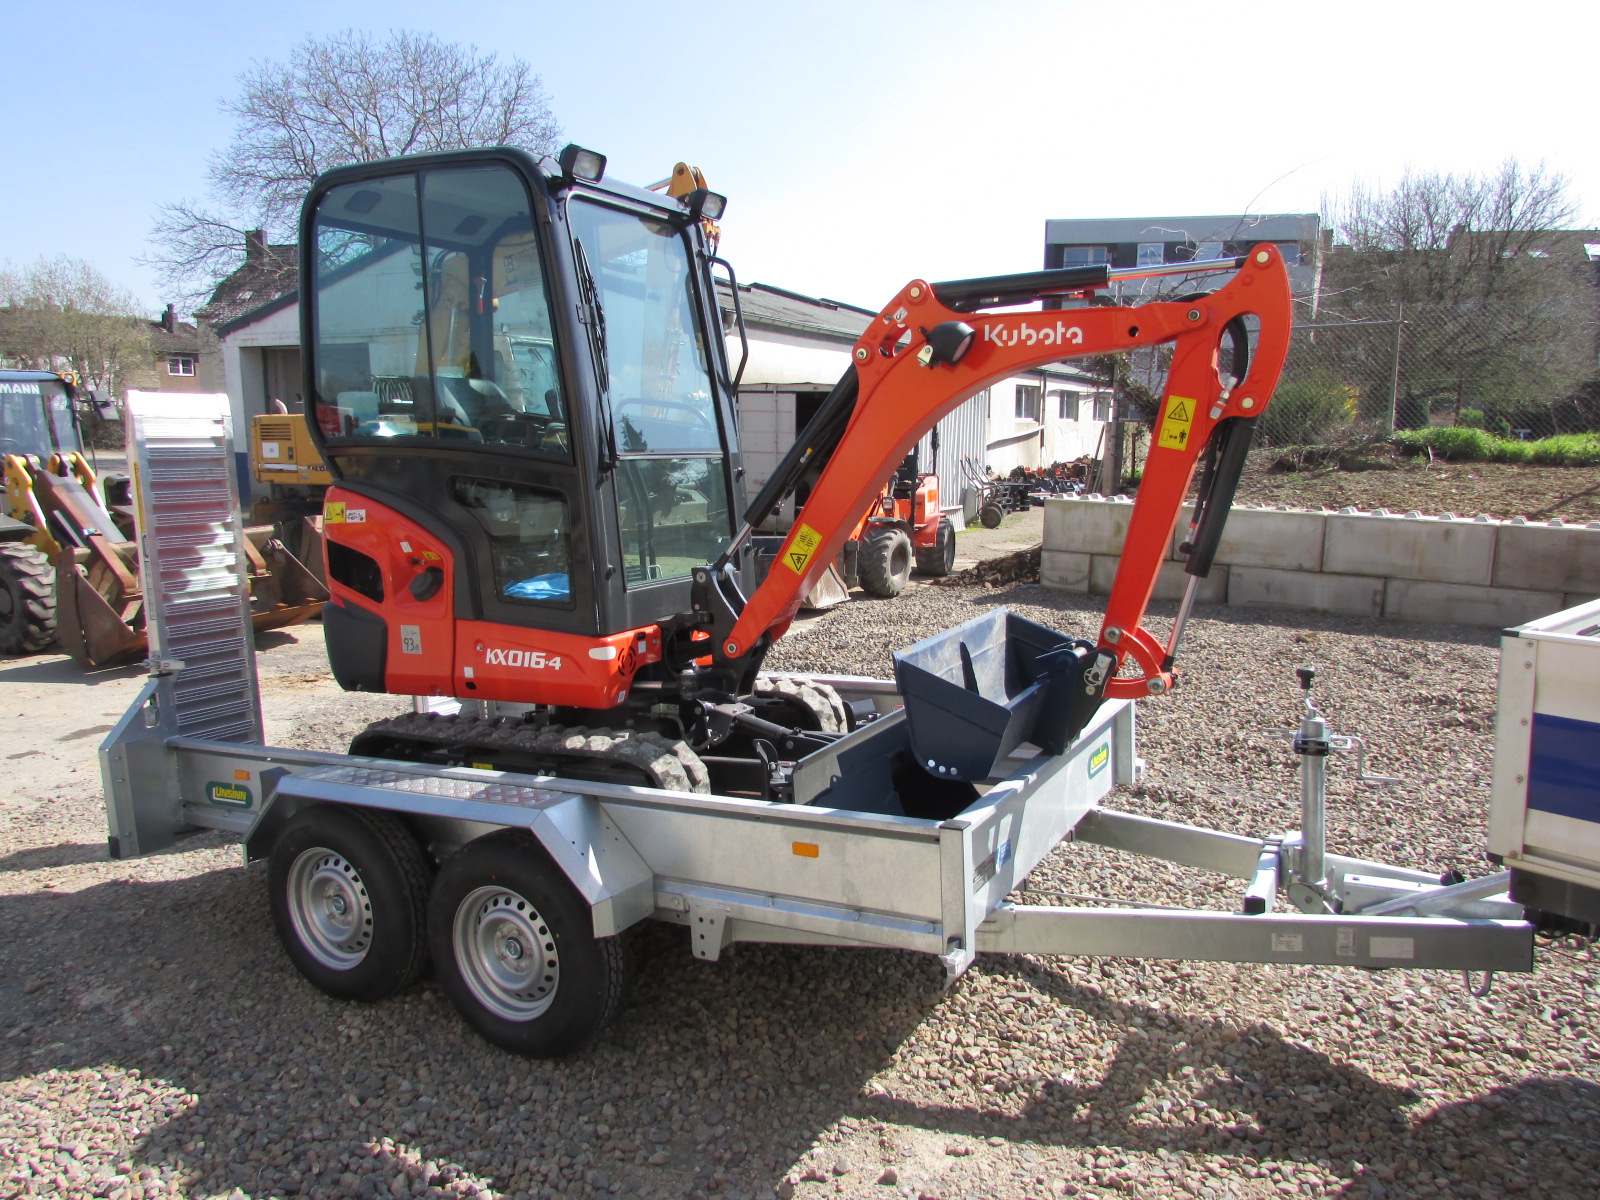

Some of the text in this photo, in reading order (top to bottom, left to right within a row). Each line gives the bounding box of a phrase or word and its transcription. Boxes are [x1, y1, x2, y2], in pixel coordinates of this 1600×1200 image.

[984, 321, 1083, 347] Kubota
[403, 637, 415, 651] 93
[213, 785, 247, 801] UNSINN
